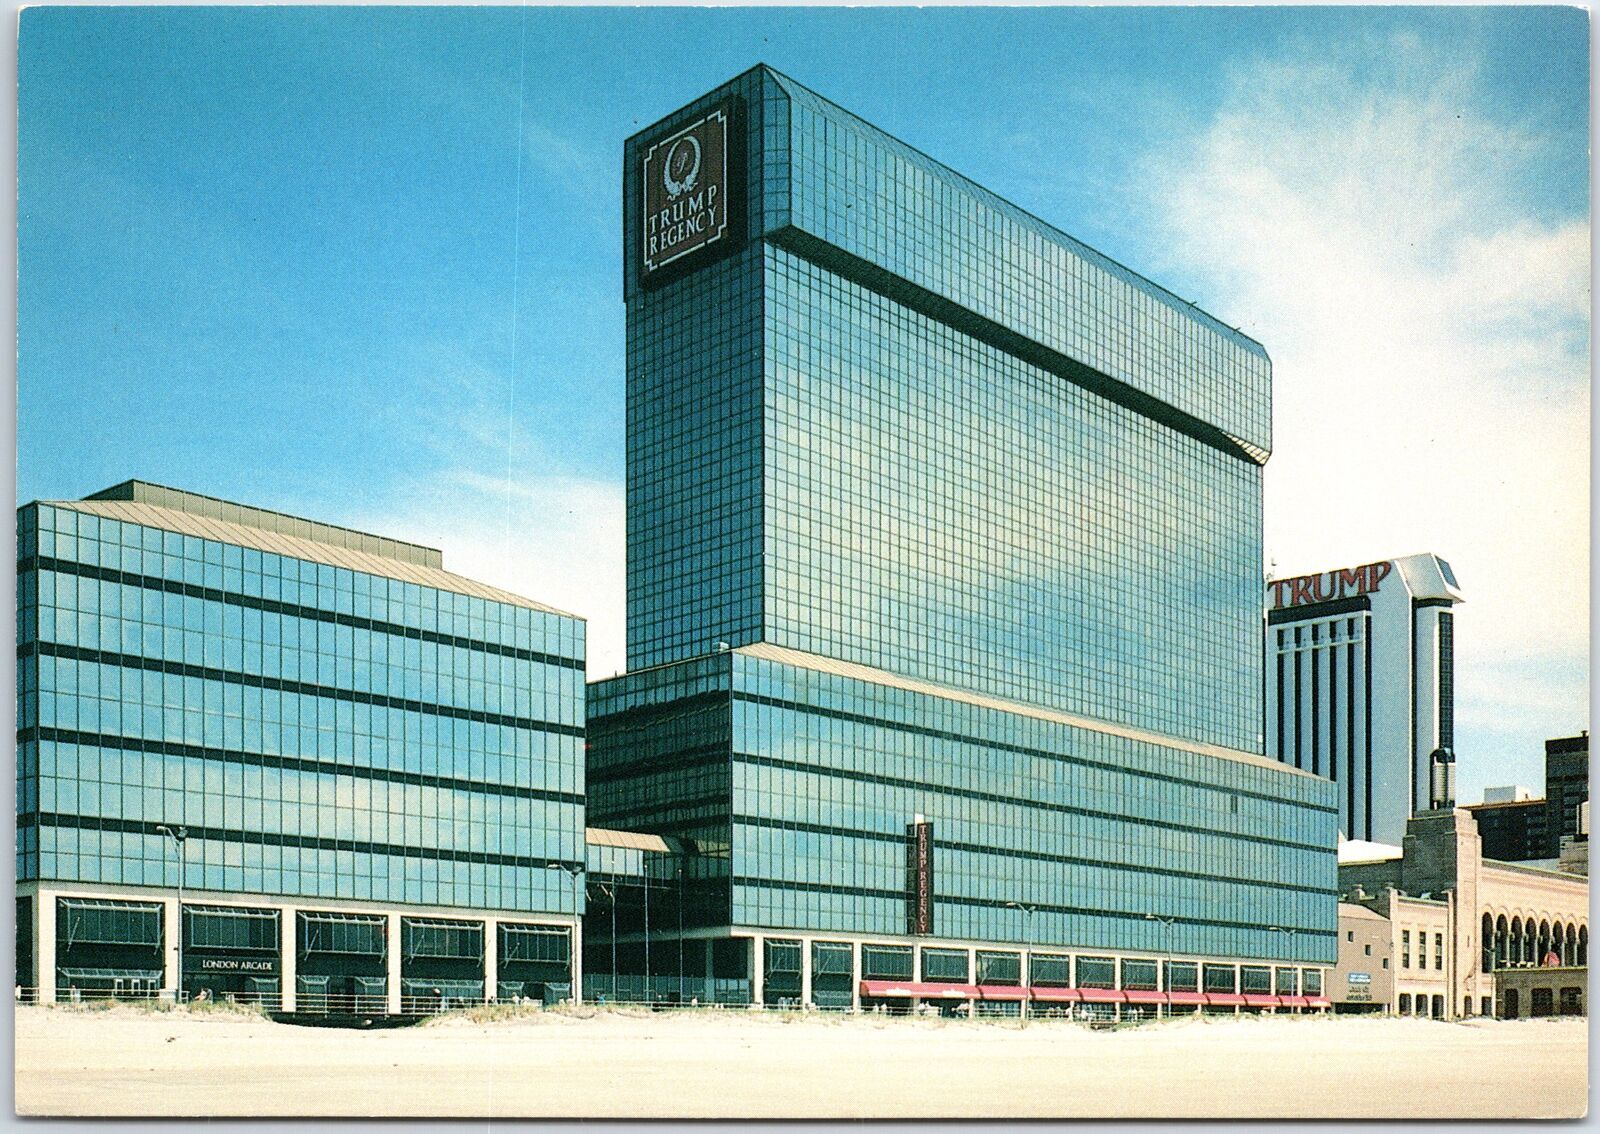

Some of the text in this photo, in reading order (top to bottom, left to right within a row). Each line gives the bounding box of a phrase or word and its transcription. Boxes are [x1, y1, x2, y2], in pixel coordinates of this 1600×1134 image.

[649, 185, 717, 235] TRUMP
[650, 206, 717, 256] REGENCY
[1267, 561, 1392, 609] TRUMP
[920, 825, 928, 932] TRUMP REGENCY
[202, 959, 273, 970] LONDON ARCADE
